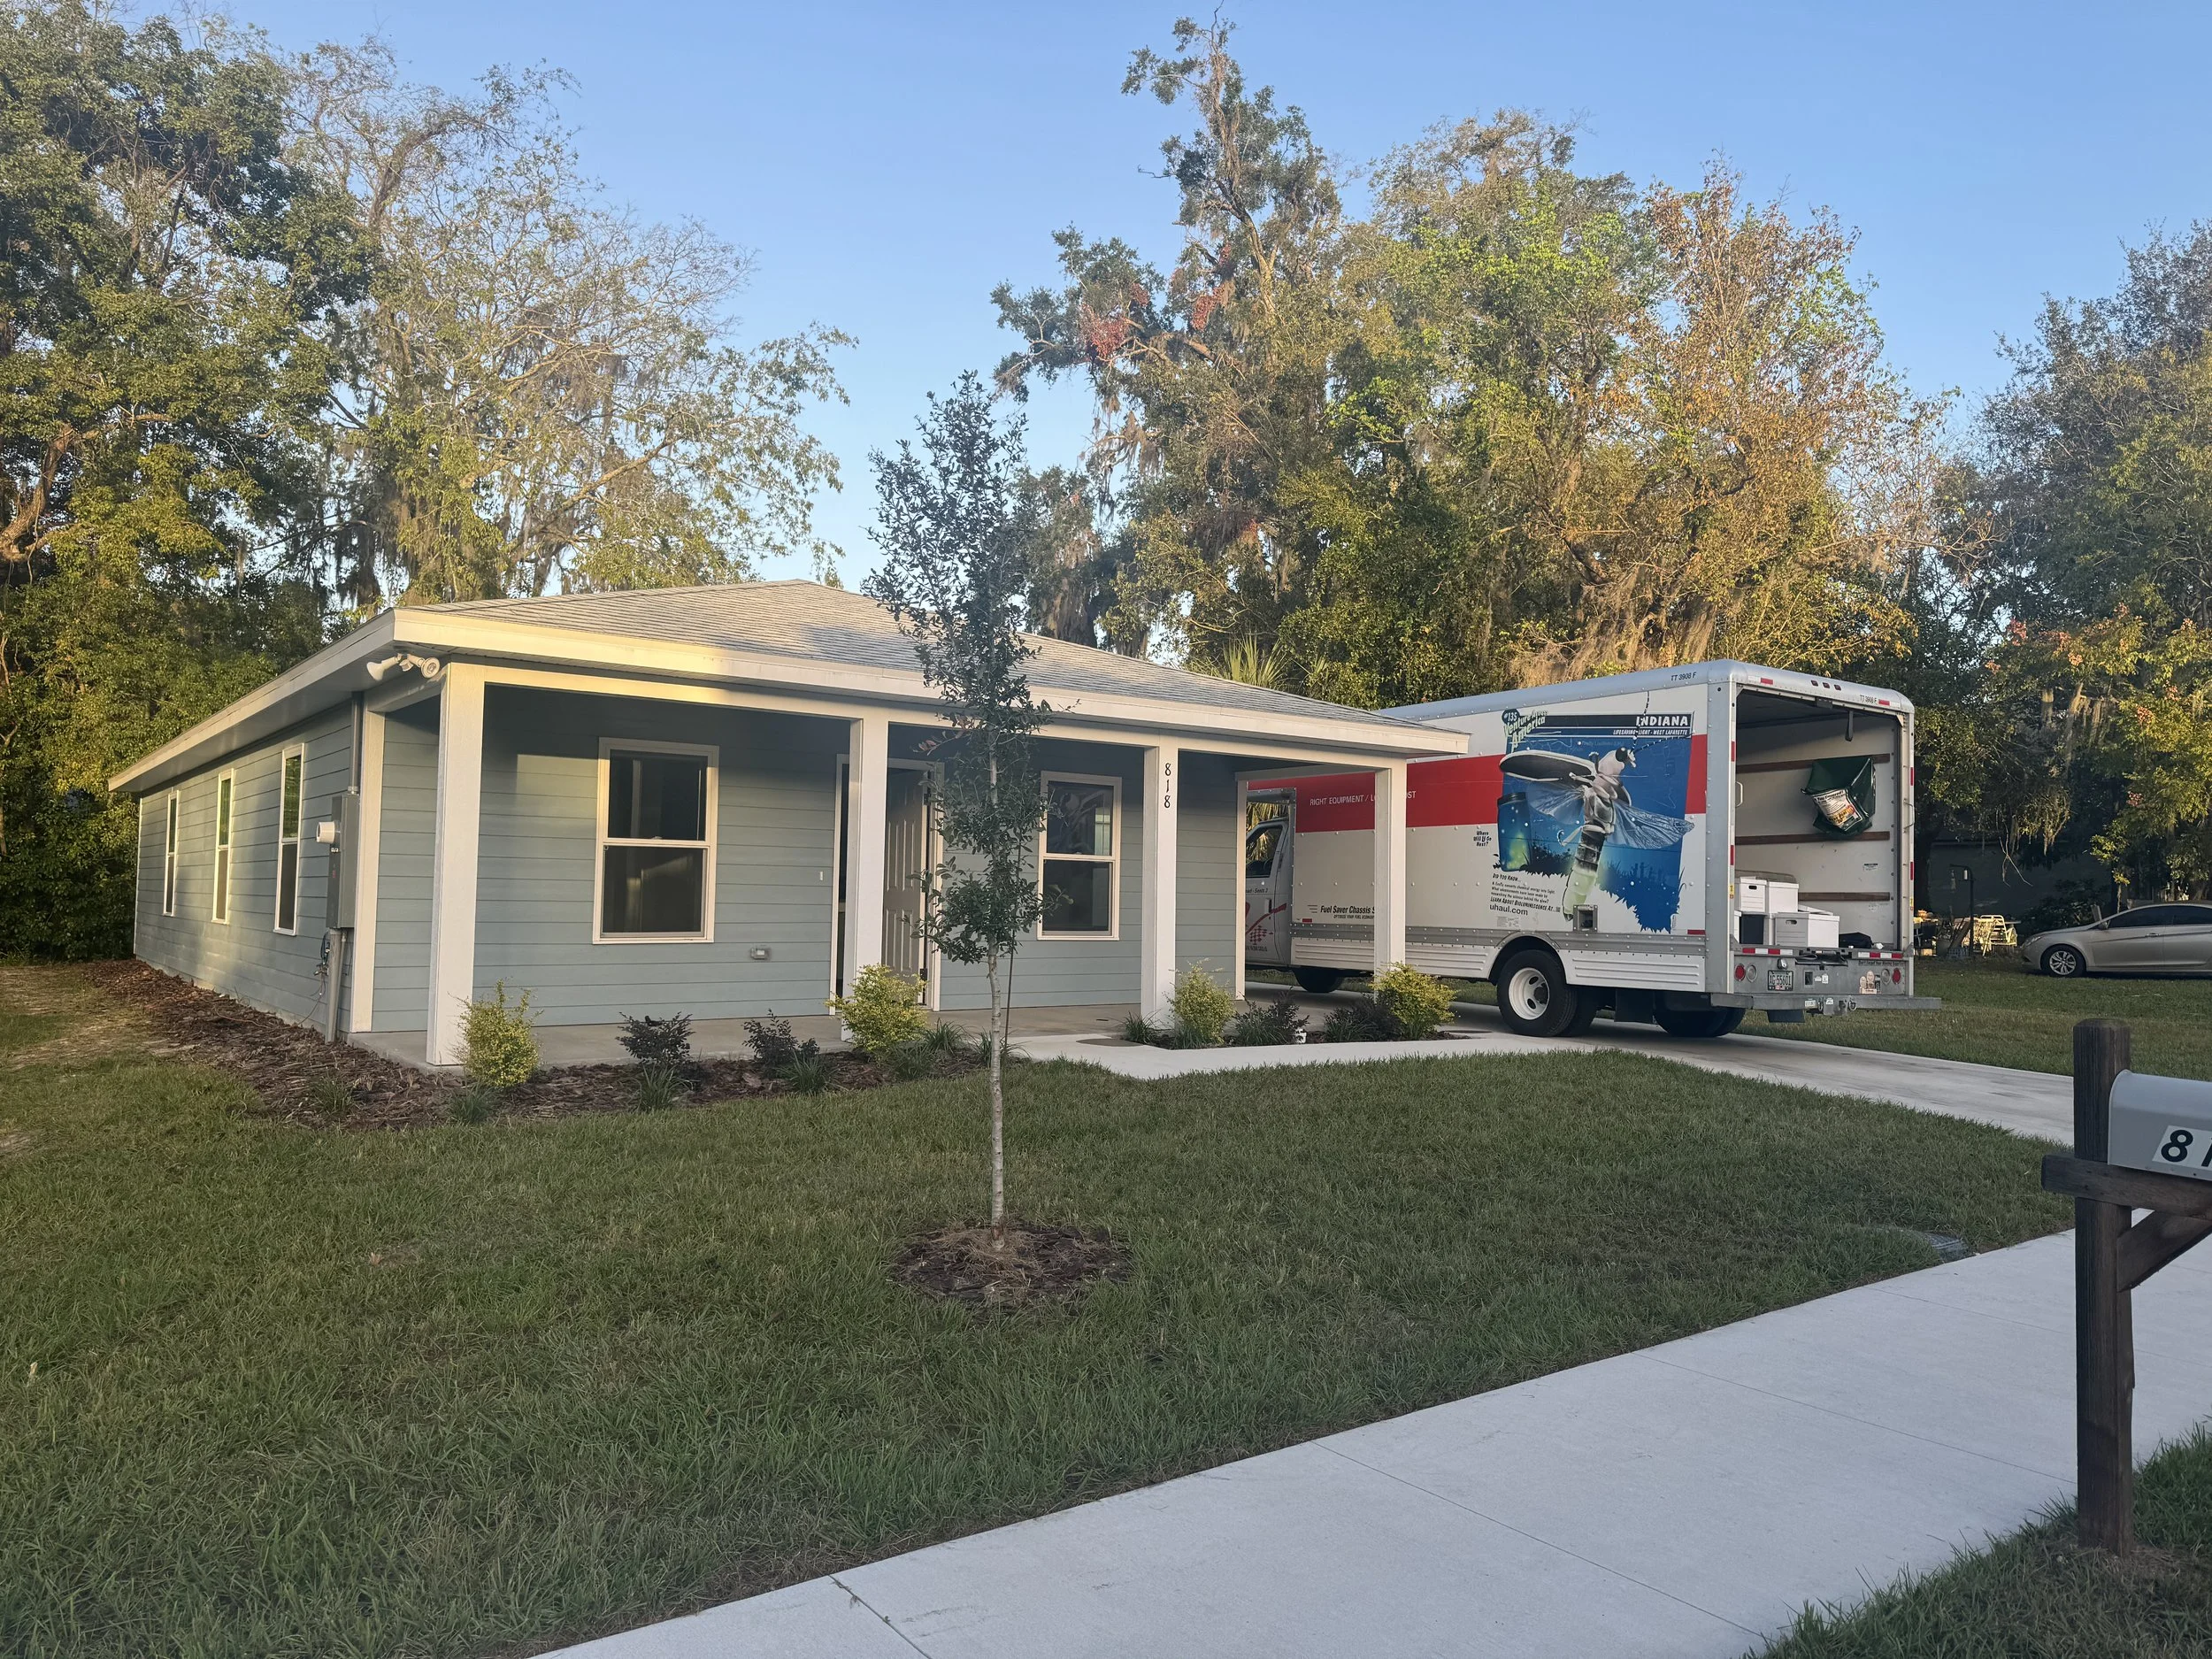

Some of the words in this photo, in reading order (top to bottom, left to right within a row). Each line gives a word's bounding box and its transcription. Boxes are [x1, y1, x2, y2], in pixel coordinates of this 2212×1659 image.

[1504, 715, 1531, 737] Venture
[1636, 716, 1688, 726] INDIANA
[1511, 717, 1546, 754] America
[1310, 797, 1327, 806] RIGHT
[1329, 795, 1364, 804] EQUIPMENT
[1333, 904, 1348, 914] Saver
[1348, 905, 1371, 914] Chassis
[1489, 903, 1528, 916] uhaul.com
